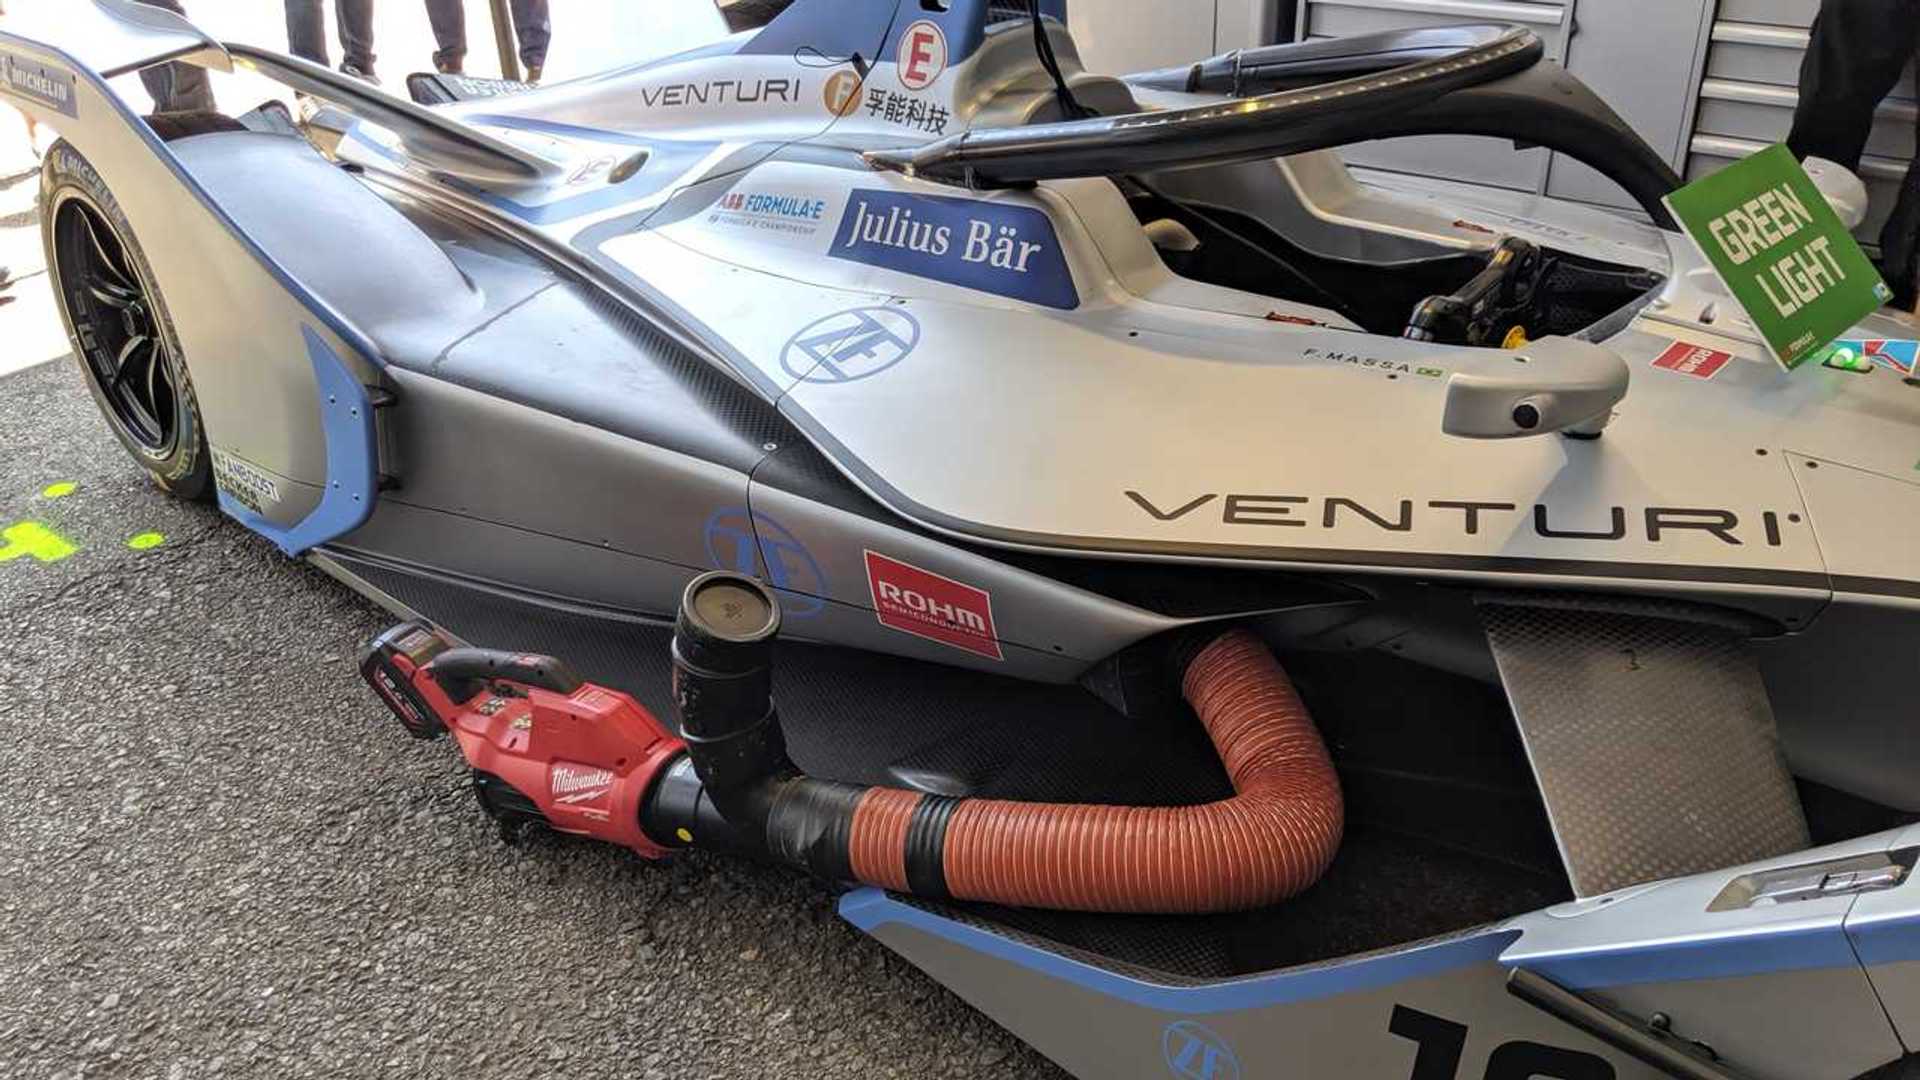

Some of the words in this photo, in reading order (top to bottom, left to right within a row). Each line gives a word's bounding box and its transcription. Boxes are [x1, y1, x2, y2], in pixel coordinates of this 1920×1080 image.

[11, 66, 68, 102] MICHELIN
[641, 79, 801, 107] VENTURI
[865, 88, 950, 135] 孚能科技
[846, 202, 951, 255] Julius
[961, 219, 1042, 273] Bär
[1708, 182, 1814, 265] GREEN
[1755, 236, 1846, 318] LIGHT
[795, 308, 912, 381] ZF
[1124, 490, 1783, 547] VENTURI
[552, 767, 614, 793] Milwaukee
